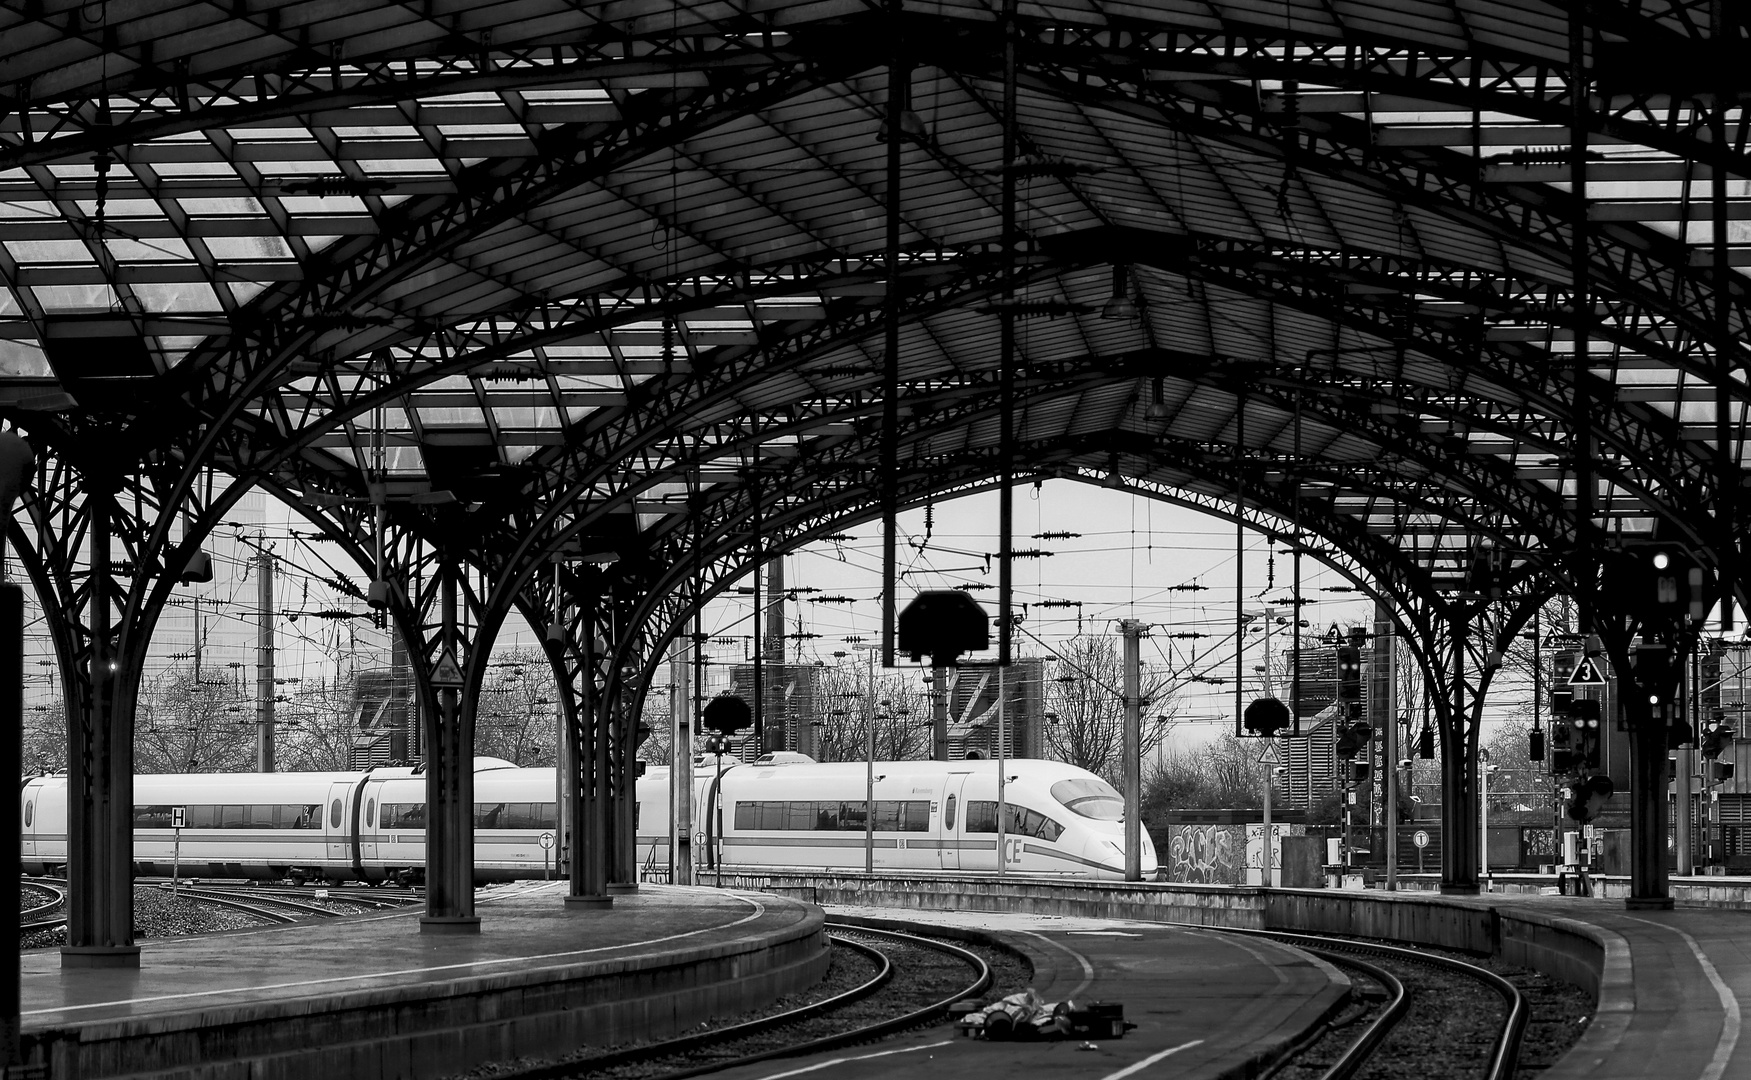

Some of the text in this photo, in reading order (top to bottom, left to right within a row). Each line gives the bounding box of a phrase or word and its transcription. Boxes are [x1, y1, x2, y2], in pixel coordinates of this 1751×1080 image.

[1582, 662, 1591, 681] 3
[173, 808, 184, 826] H
[1004, 838, 1022, 864] CE
